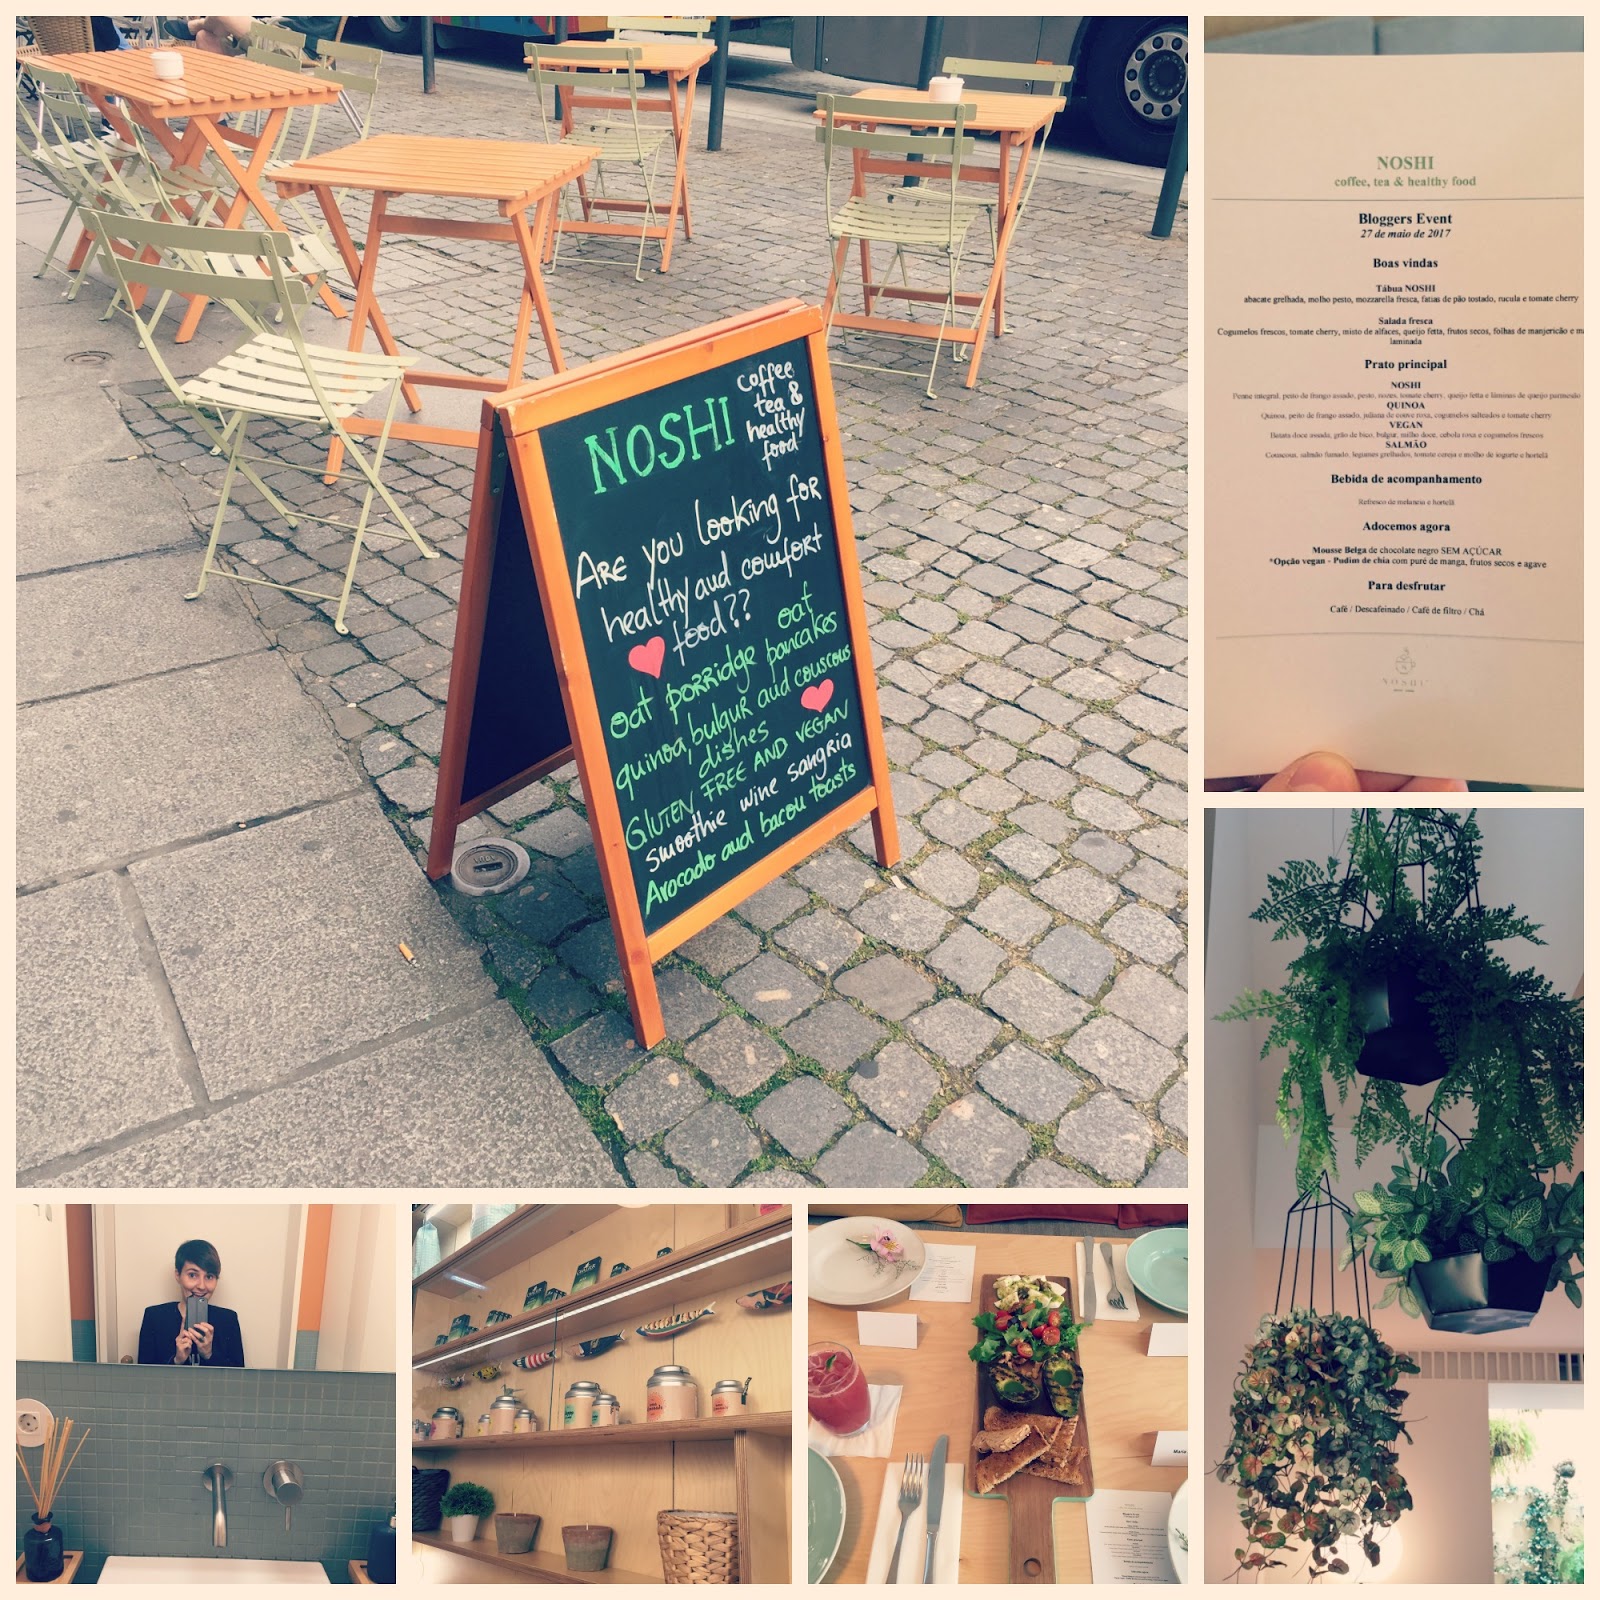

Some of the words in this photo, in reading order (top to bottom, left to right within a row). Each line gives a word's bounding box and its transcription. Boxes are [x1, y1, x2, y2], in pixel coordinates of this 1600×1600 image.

[1376, 155, 1435, 169] NOSHI
[1334, 175, 1371, 187] coffee,
[1373, 177, 1390, 186] tea
[1393, 176, 1403, 186] &
[1407, 176, 1448, 188] healthy
[1452, 175, 1476, 186] food
[1358, 212, 1413, 227] Bloggers
[1416, 212, 1453, 224] Event
[1360, 228, 1373, 237] 27
[1374, 228, 1386, 238] de
[1387, 228, 1412, 238] maio
[1413, 228, 1426, 238] de
[1427, 228, 1452, 238] 2017
[1372, 257, 1400, 268] Boas
[1402, 257, 1439, 267] vindas
[1377, 284, 1403, 293] Tábua
[1405, 284, 1436, 293] NOSHI
[1244, 295, 1272, 304] abacate
[1273, 295, 1306, 304] grelhada,
[1307, 295, 1331, 304] molho
[1332, 296, 1354, 305] pesto,
[1355, 295, 1395, 304] mozzarella
[1396, 295, 1420, 304] fresca,
[1421, 295, 1441, 303] fatias
[1442, 295, 1452, 303] de
[1453, 295, 1467, 304] pão
[1468, 295, 1496, 303] tostado,
[1498, 294, 1521, 303] rucula
[1555, 293, 1579, 303] cherry
[1378, 317, 1407, 325] Salada
[1408, 316, 1433, 325] fresca
[1217, 327, 1258, 337] Cogumelos
[1260, 327, 1288, 336] frescos,
[1289, 328, 1314, 336] tomate
[1315, 327, 1341, 336] cherry,
[1342, 327, 1363, 336] misto
[1364, 327, 1373, 336] de
[1374, 327, 1401, 336] alfaces,
[1403, 329, 1426, 337] queijo
[1447, 327, 1468, 335] frutos
[1469, 328, 1491, 336] secos,
[1493, 327, 1515, 335] folhas
[1516, 327, 1526, 335] de
[1527, 326, 1568, 336] manjericão
[1390, 337, 1423, 345] laminada
[1364, 359, 1395, 368] Prato
[1398, 359, 1447, 371] principal
[1390, 381, 1422, 389] NOSHI
[754, 393, 785, 417] tea
[788, 380, 803, 406] &
[1385, 401, 1426, 410] QUINOA
[746, 407, 806, 443] healthy
[1388, 421, 1424, 429] VEGAN
[584, 396, 736, 495] NOSHI
[1384, 439, 1428, 448] SALMÃO
[762, 433, 799, 472] food
[1330, 473, 1369, 483] Bebida
[1370, 473, 1385, 483] de
[1386, 474, 1483, 485] acompanhamento
[694, 493, 782, 546] looking
[1362, 521, 1418, 530] Adocemos
[1419, 523, 1451, 533] agora
[1311, 546, 1343, 554] Mousse
[1344, 546, 1367, 555] Belga
[1368, 546, 1378, 554] de
[1379, 546, 1416, 554] chocolate
[1417, 548, 1440, 557] negro
[1441, 546, 1461, 555] SEM
[1462, 545, 1503, 556] AÇÚCAR
[1302, 558, 1326, 567] vegan
[1333, 556, 1361, 564] Pudim
[1362, 556, 1372, 564] de
[1373, 556, 1391, 565] chia
[1410, 558, 1427, 567] puré
[1428, 557, 1439, 565] de
[1440, 558, 1468, 567] manga,
[1469, 557, 1493, 566] frutos
[1494, 560, 1516, 568] secos
[1524, 561, 1547, 570] agave
[1367, 580, 1394, 590] Para
[1395, 580, 1446, 591] desfrutar
[601, 576, 690, 642] healthy
[695, 550, 732, 601] and
[776, 580, 814, 630] oat
[1329, 605, 1349, 613] Café
[1354, 604, 1406, 613] Descafeinado
[1411, 605, 1431, 614] Café
[1432, 606, 1442, 615] de
[1443, 606, 1463, 615] filtro
[1468, 607, 1485, 616] Chá
[673, 587, 752, 667] food??
[609, 686, 654, 739] oat
[765, 610, 838, 682] pancakes
[756, 666, 791, 709] and
[794, 643, 852, 688] couscous
[698, 720, 770, 779] dishes
[700, 762, 747, 802] FREE
[753, 736, 789, 772] AND
[795, 699, 849, 744] VEGAN
[739, 777, 779, 813] wine
[720, 819, 755, 862] and
[759, 795, 807, 837] bacon
[808, 757, 857, 802] toasts
